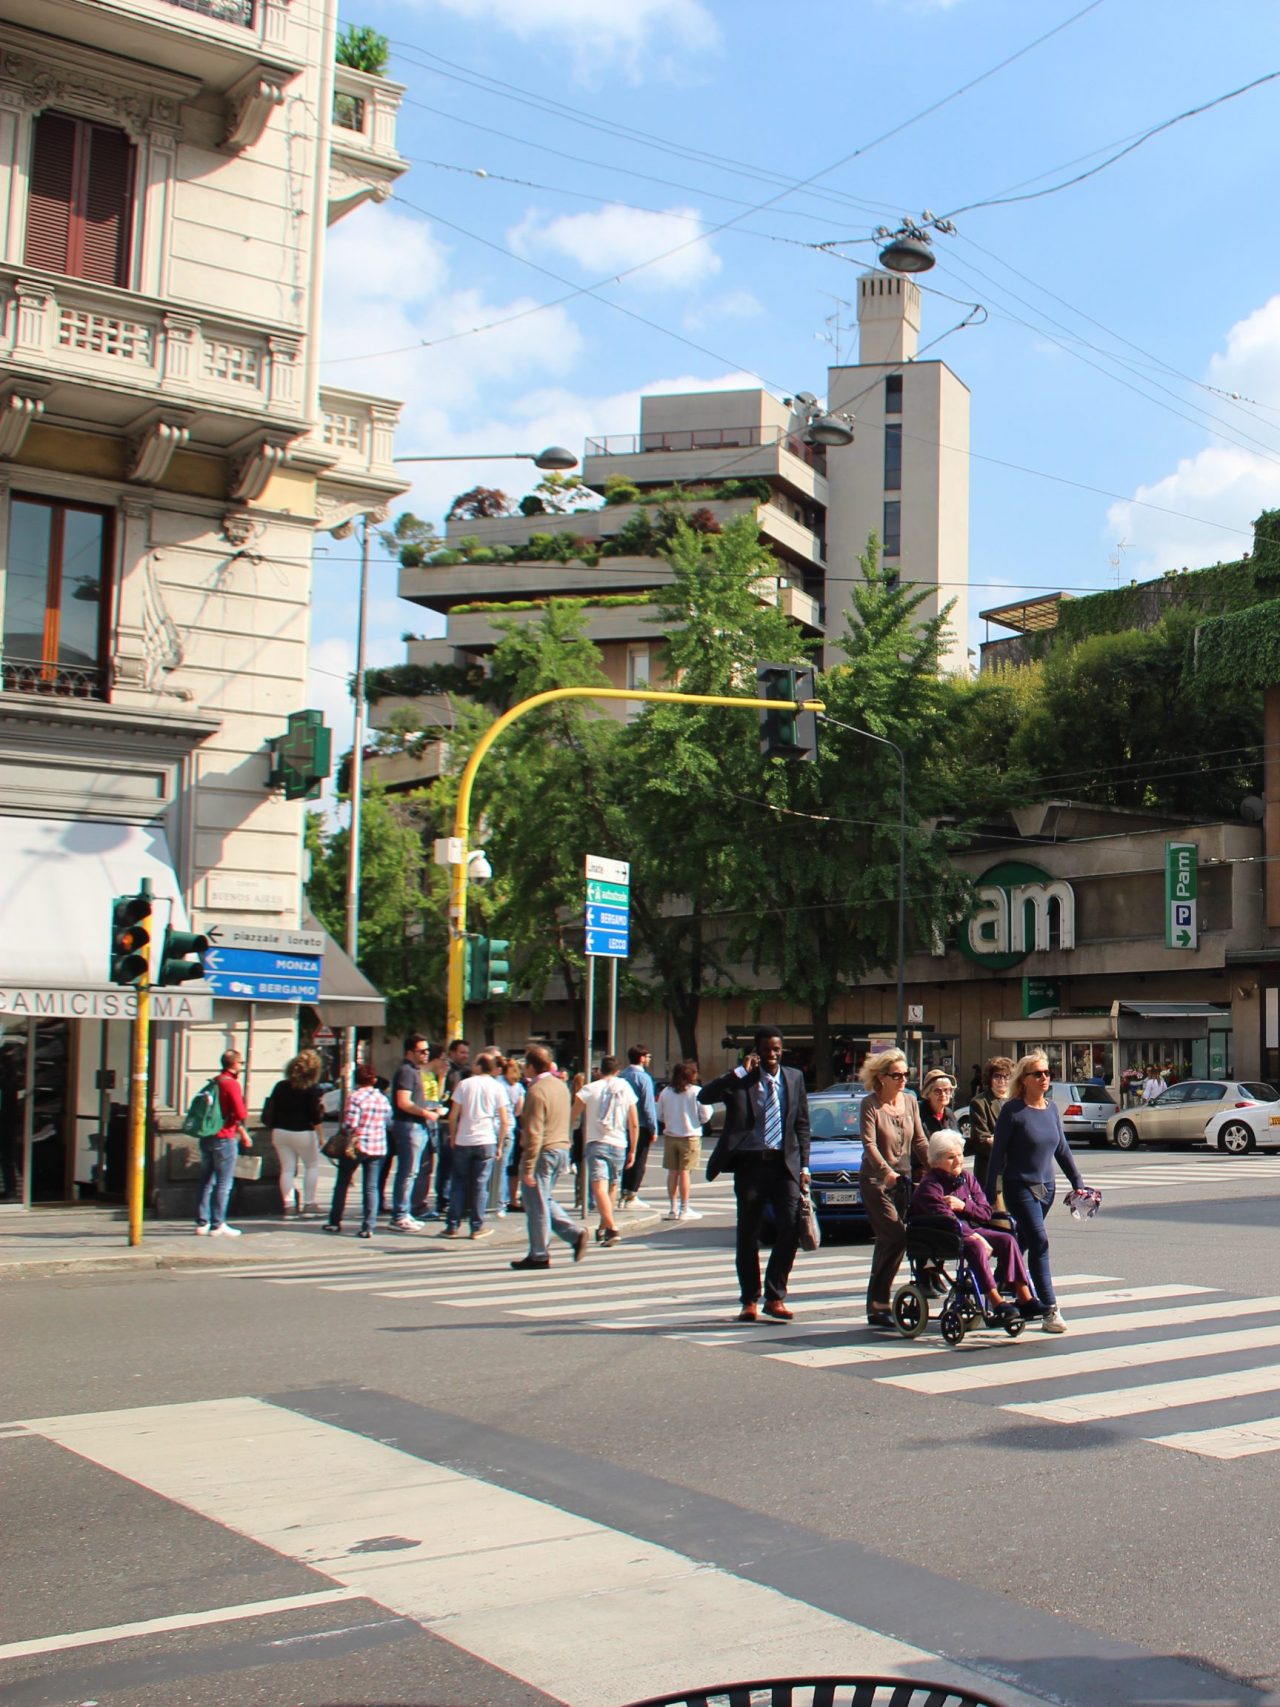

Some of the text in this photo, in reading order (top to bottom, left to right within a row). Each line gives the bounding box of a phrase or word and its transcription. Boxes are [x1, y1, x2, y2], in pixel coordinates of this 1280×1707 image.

[1176, 851, 1190, 897] Pam
[212, 892, 283, 904] BUENOS AIRES
[932, 880, 1075, 956] am
[1178, 907, 1190, 924] P
[234, 931, 321, 947] piazzale loreto
[276, 959, 318, 972] MONZA
[258, 982, 316, 996] BERGAMO
[0, 991, 194, 1018] AMICISSMA
